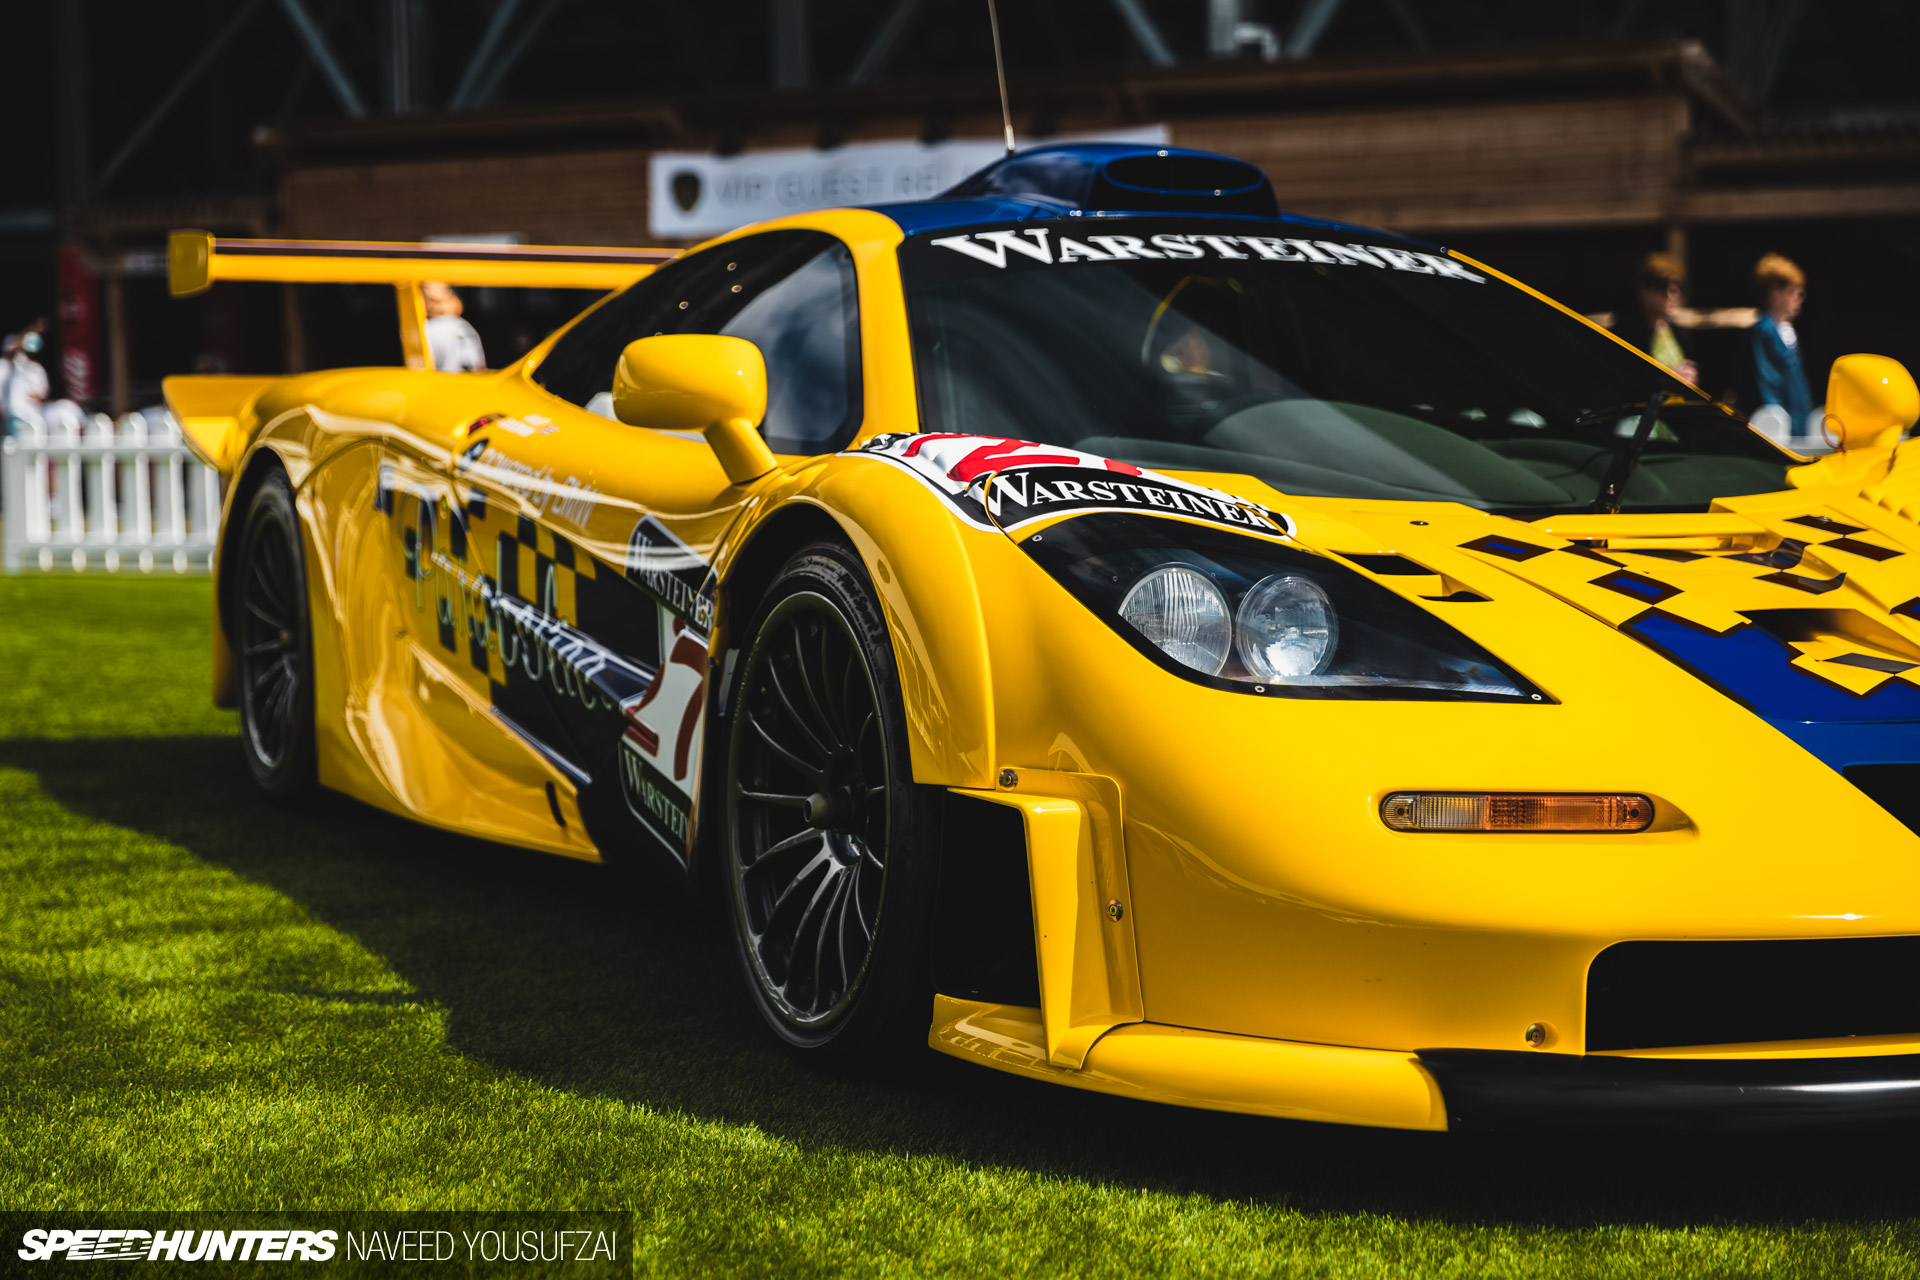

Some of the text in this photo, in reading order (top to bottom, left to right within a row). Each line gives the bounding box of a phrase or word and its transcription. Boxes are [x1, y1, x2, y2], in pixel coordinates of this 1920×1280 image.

[931, 228, 1487, 284] WARSTEINER
[966, 472, 1279, 531] WARSTEINER
[625, 616, 709, 781] 27
